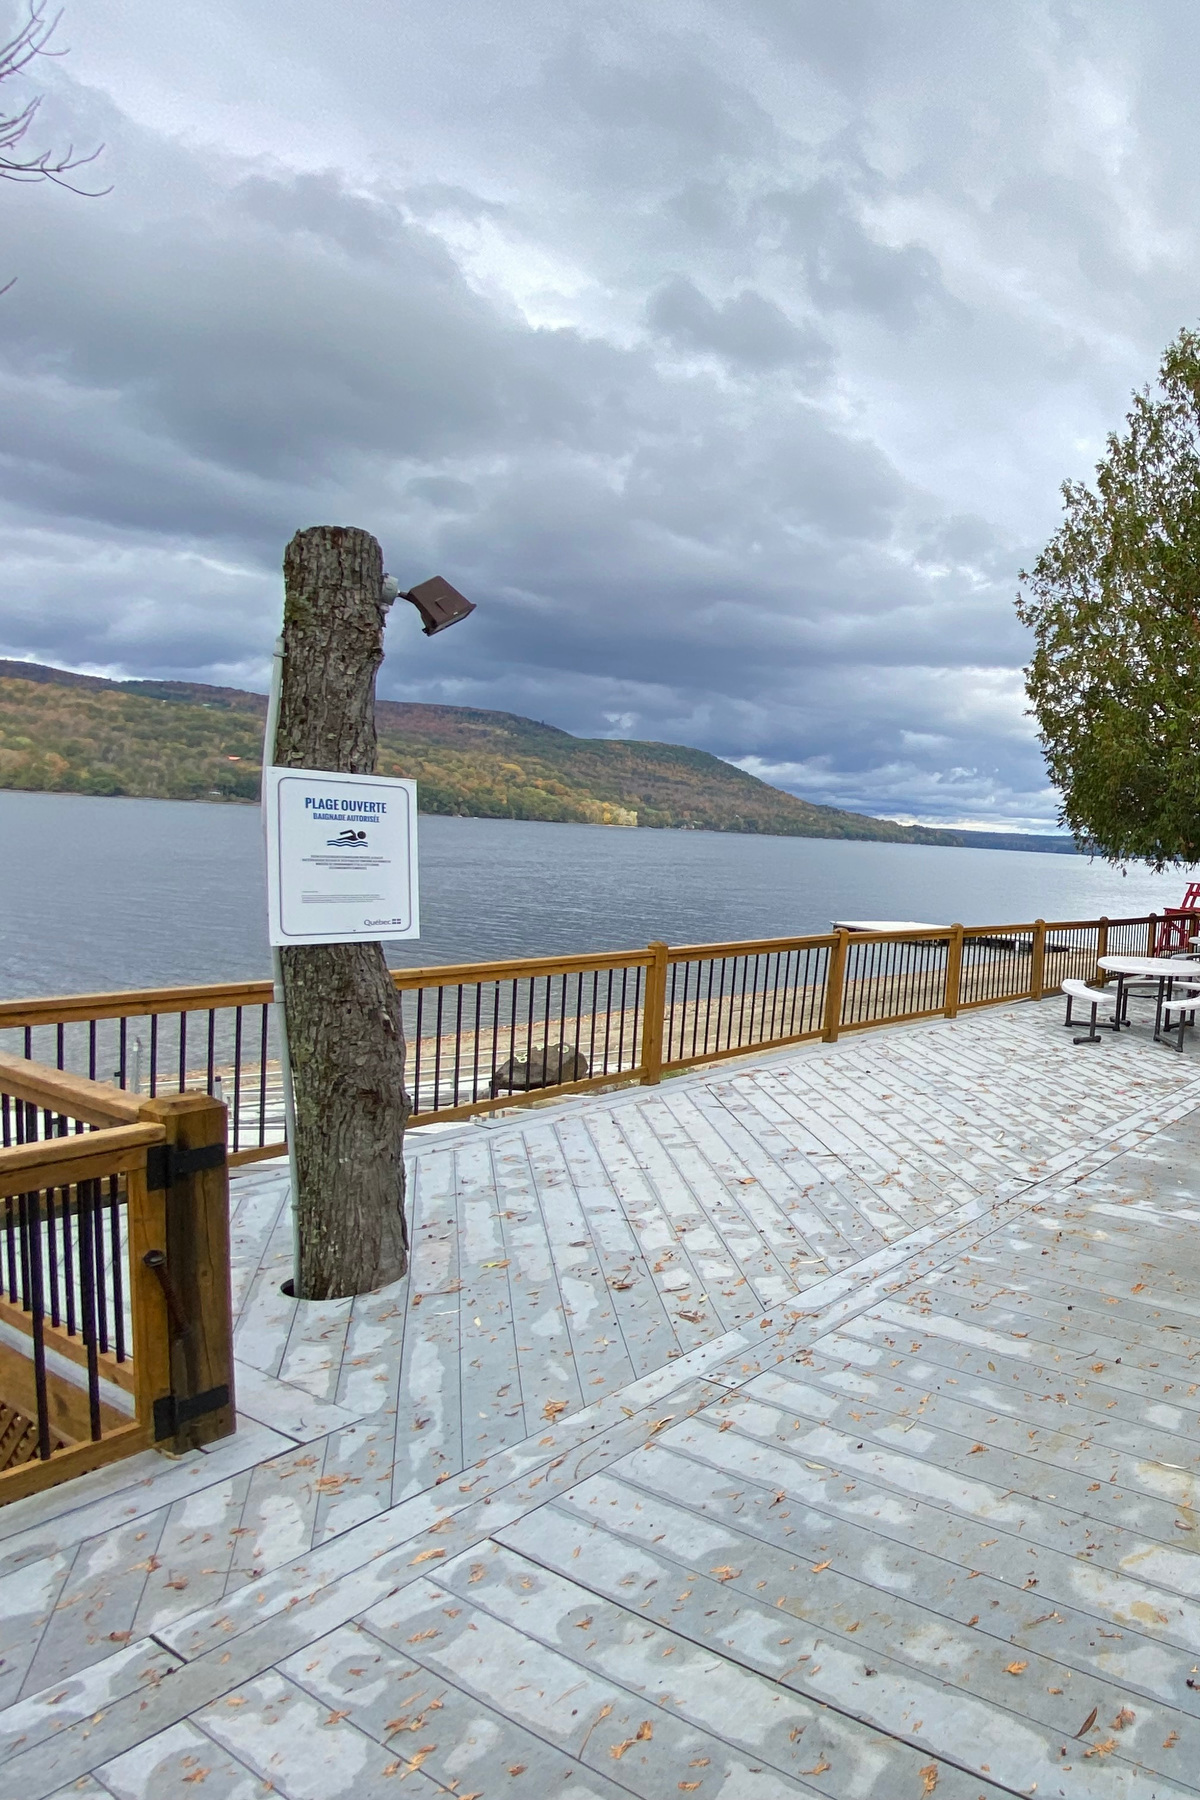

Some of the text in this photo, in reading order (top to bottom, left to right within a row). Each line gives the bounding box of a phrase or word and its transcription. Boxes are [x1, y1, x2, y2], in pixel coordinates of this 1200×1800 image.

[305, 797, 387, 813] PLAGE OUVERTE
[313, 812, 380, 823] BAIGNADE AUTORISÉE
